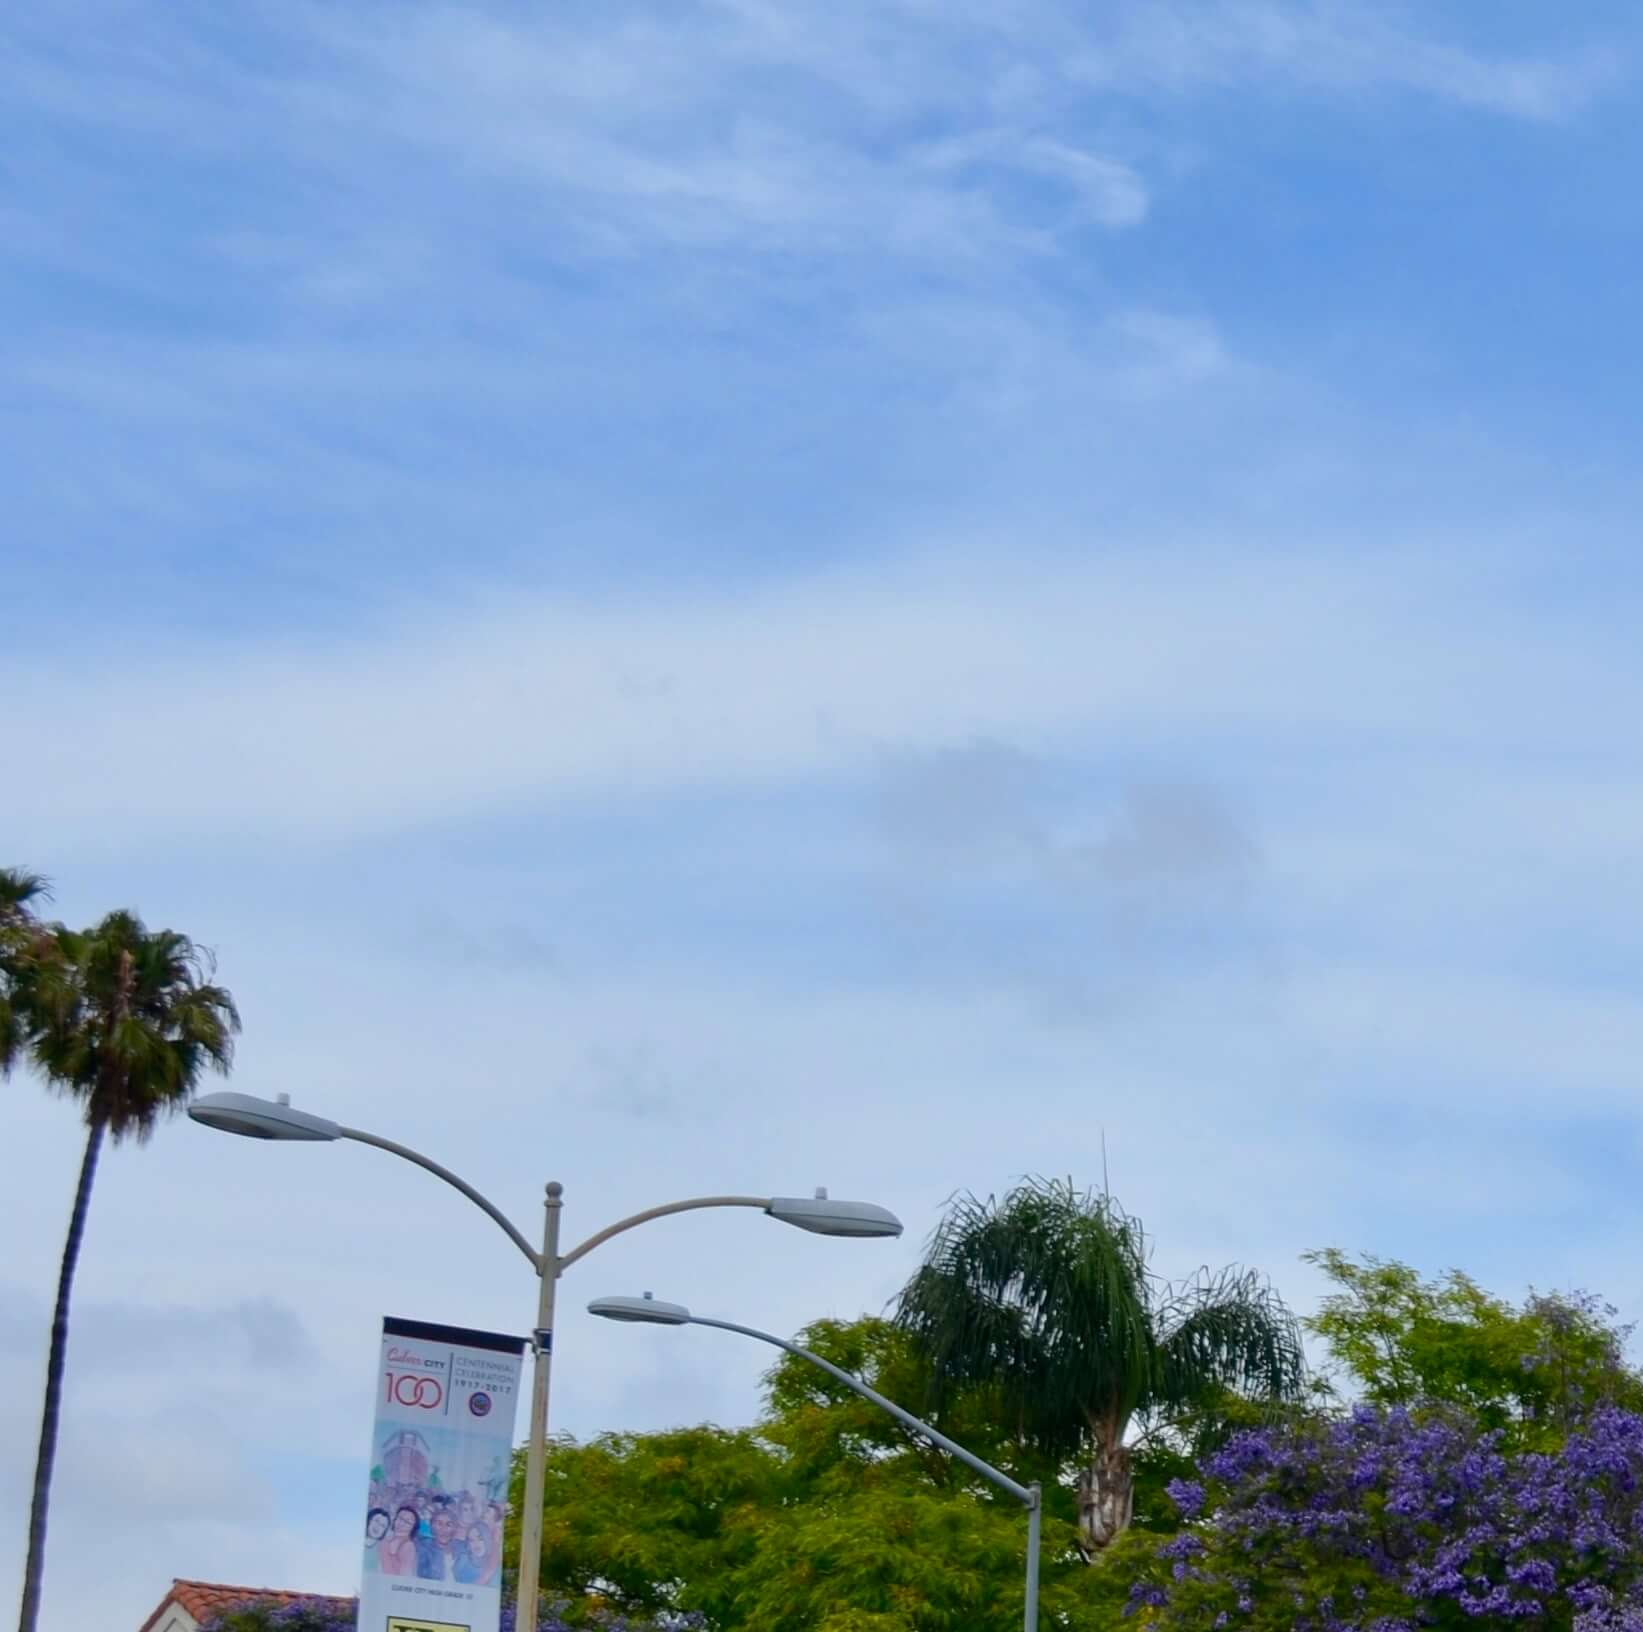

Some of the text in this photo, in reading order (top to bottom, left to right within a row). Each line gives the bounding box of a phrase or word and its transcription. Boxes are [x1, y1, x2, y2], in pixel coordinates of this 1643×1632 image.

[423, 1359, 446, 1369] CITY
[455, 1356, 515, 1374] CENTENNIAL
[384, 1372, 443, 1409] 100
[455, 1379, 512, 1394] 1917-2017
